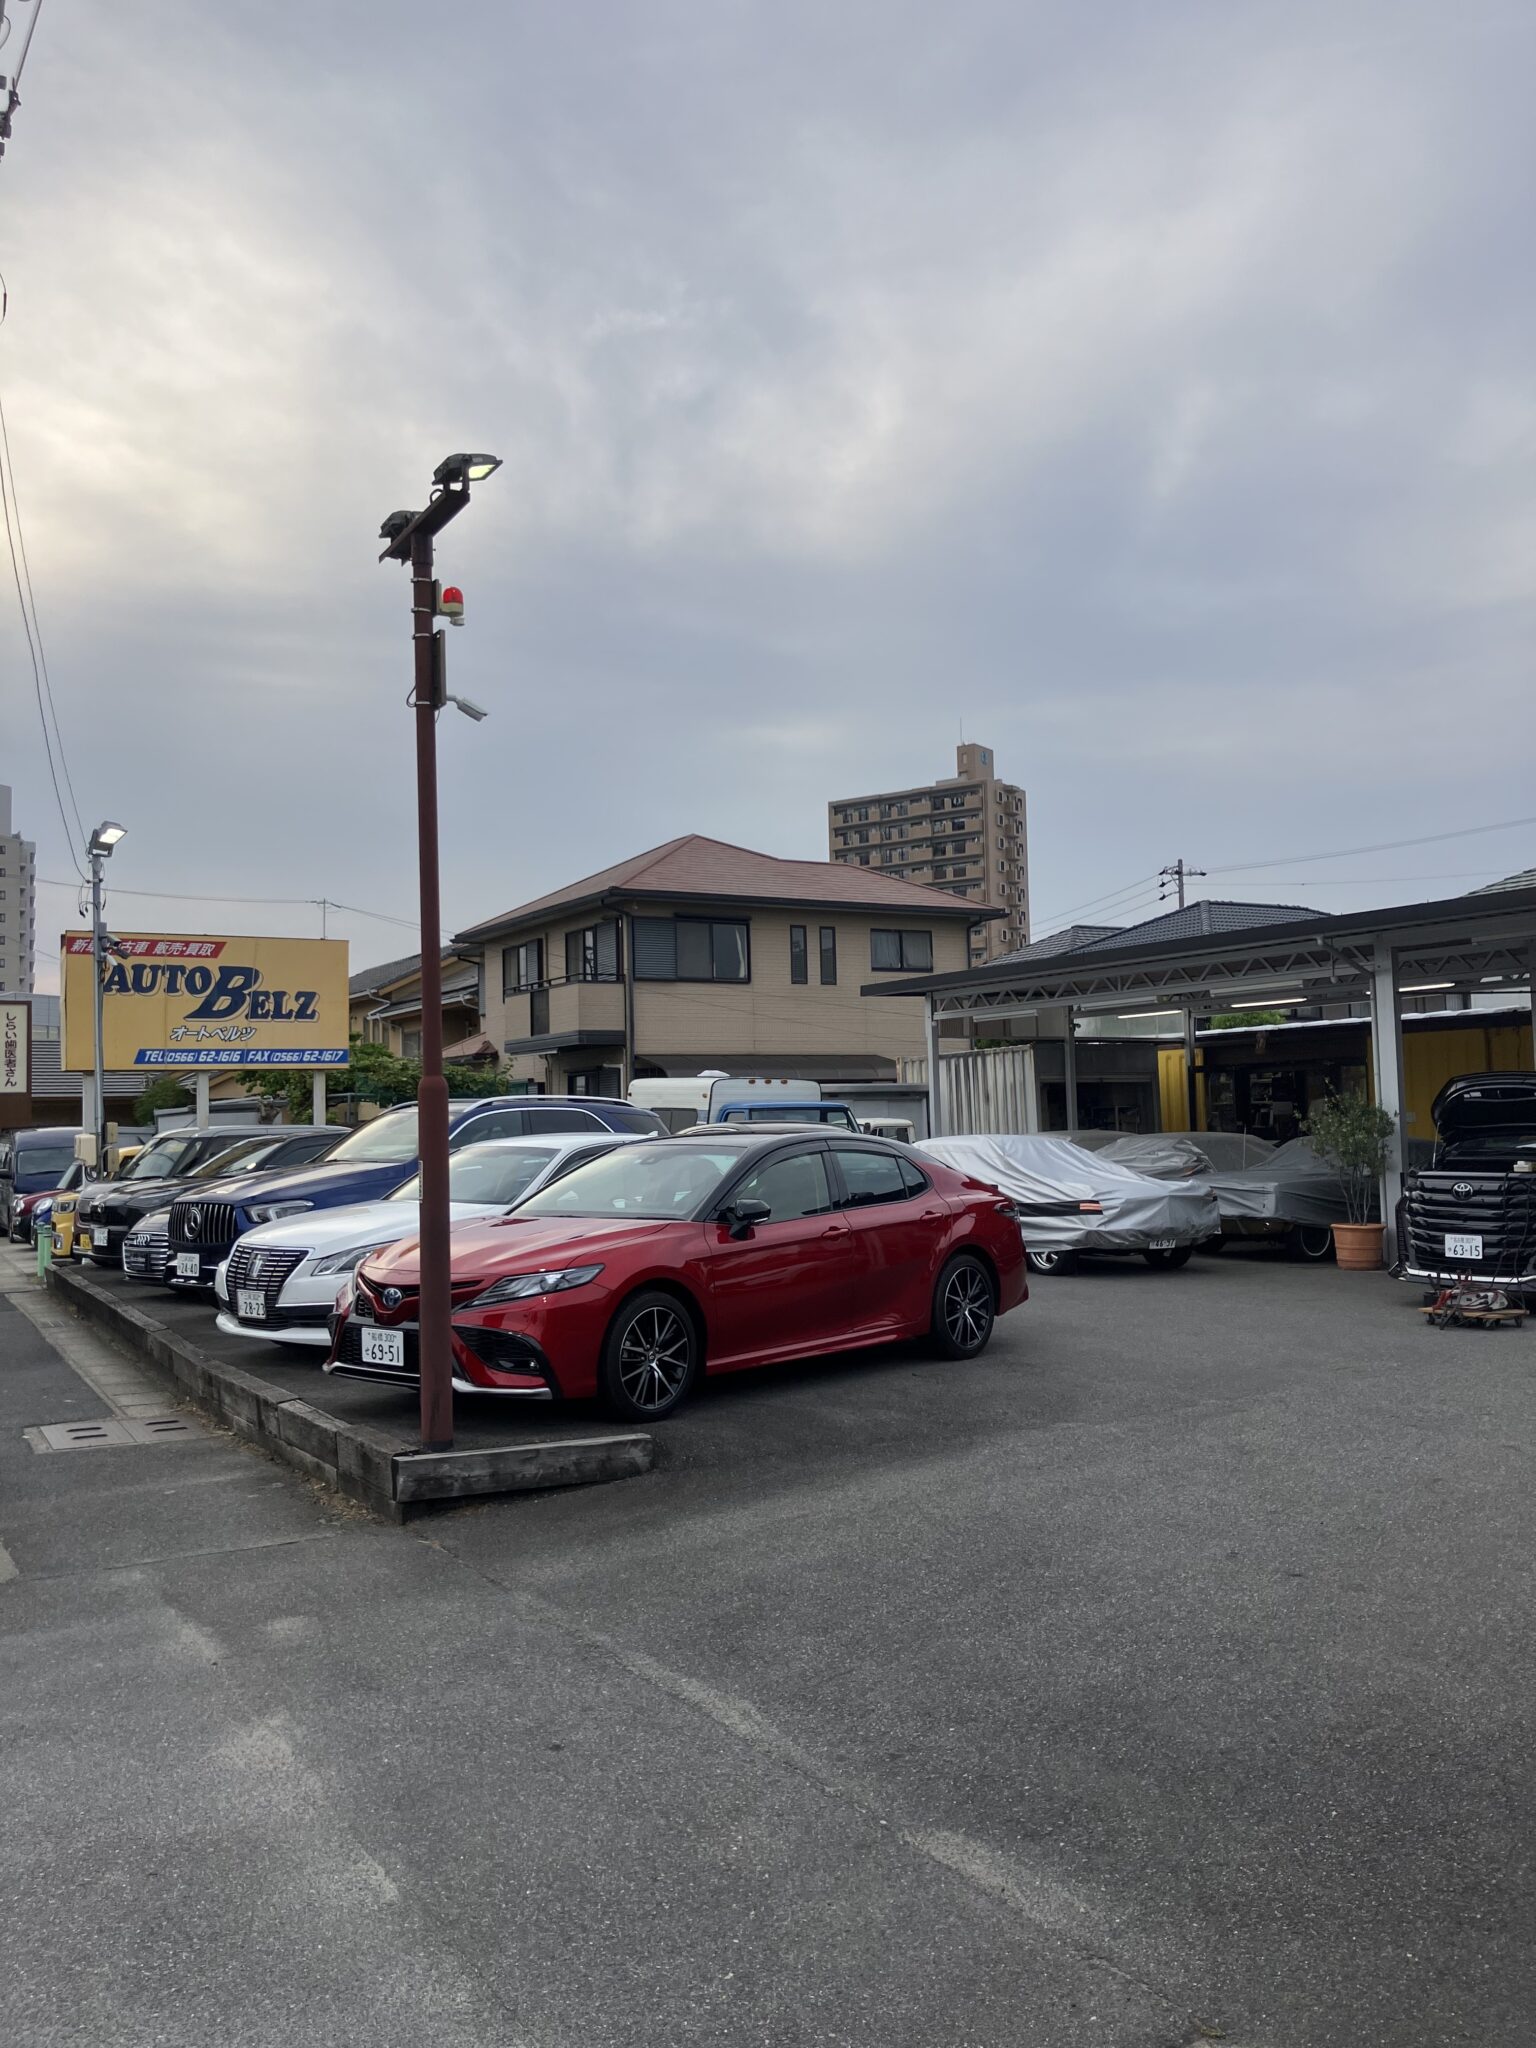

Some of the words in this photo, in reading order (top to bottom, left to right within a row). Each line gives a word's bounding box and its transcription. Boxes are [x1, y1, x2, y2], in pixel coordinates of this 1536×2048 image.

[152, 941, 216, 956] 販売・買取
[103, 963, 215, 997] AUTO
[184, 965, 319, 1022] BELZ
[169, 1025, 257, 1042] オートベルツ
[4, 1011, 17, 1087] しらい歯医者さん
[199, 1050, 242, 1062] 62-1616
[303, 1050, 344, 1062] 62-1617
[1453, 1244, 1480, 1256] 63-15
[244, 1301, 265, 1315] 28-23
[371, 1344, 400, 1363] 69-51
